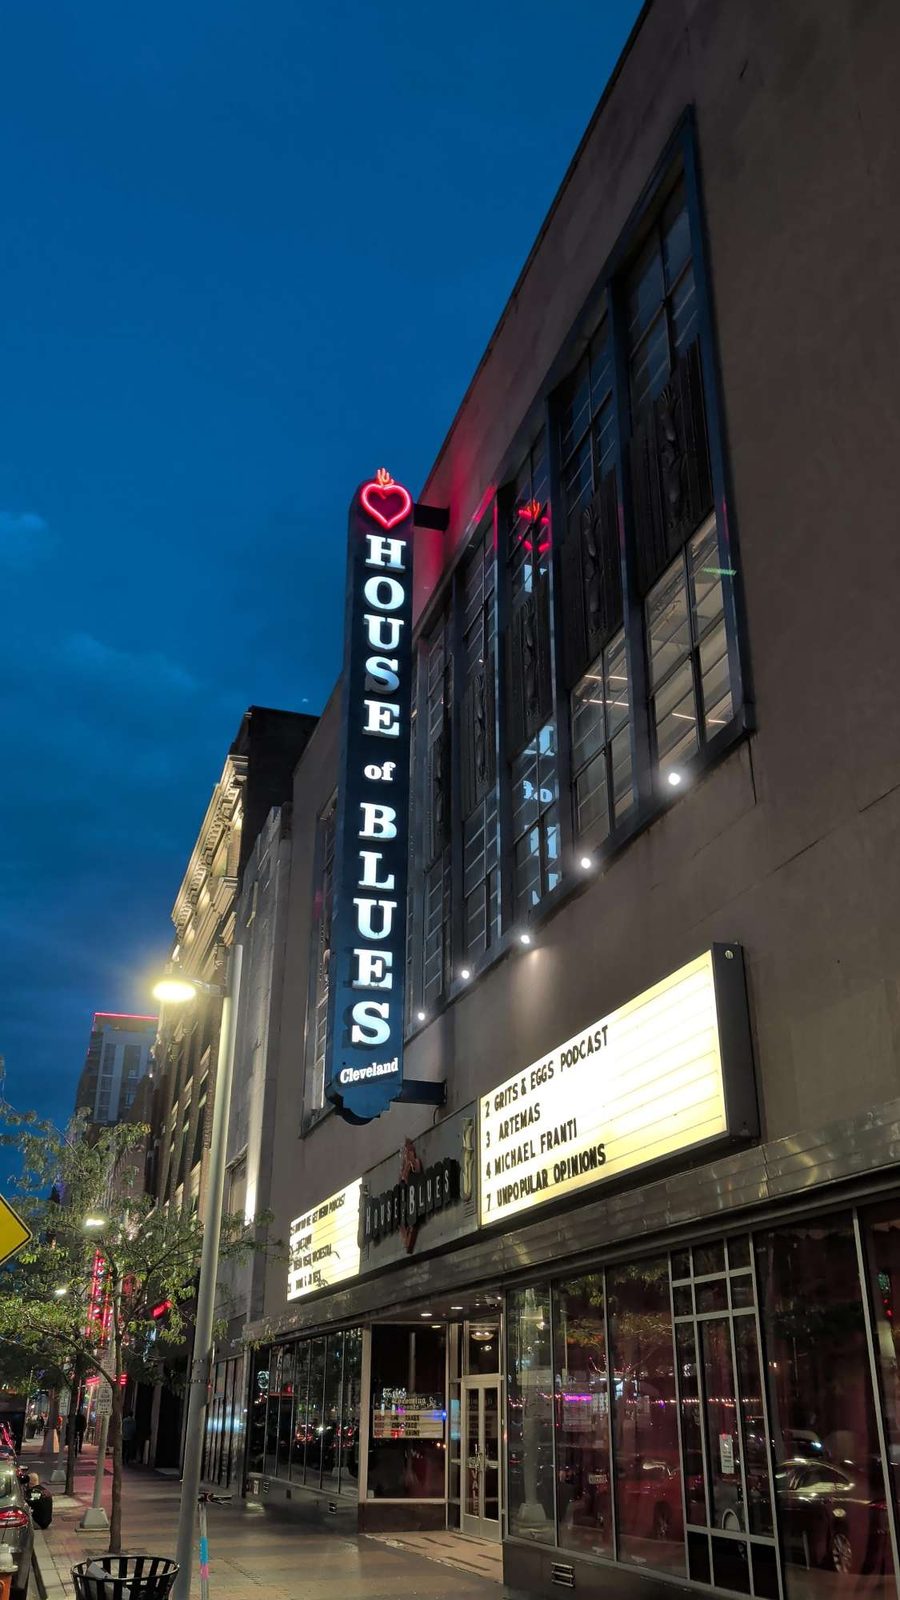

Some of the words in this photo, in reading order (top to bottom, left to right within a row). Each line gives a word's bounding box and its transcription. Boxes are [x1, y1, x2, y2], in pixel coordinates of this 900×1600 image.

[363, 533, 407, 738] HOUSE
[363, 761, 397, 782] of
[351, 801, 398, 1046] BLUES
[340, 1057, 399, 1084] Cleveland
[484, 1100, 491, 1118] 2
[494, 1082, 519, 1112] GRITS
[520, 1076, 528, 1096] &
[530, 1059, 554, 1091] EGGS
[560, 1025, 609, 1073] PODCAST
[485, 1131, 491, 1148] 3
[498, 1102, 541, 1142] ARTEMAS
[485, 1161, 491, 1180] 4
[494, 1139, 536, 1177] MICHAEL
[540, 1117, 577, 1154] FRANTI
[365, 1197, 398, 1235] HOUSE
[409, 1169, 449, 1216] BLUES
[485, 1193, 491, 1212] 7
[496, 1167, 549, 1208] UNPOPULAR
[553, 1143, 607, 1185] OPINIONS
